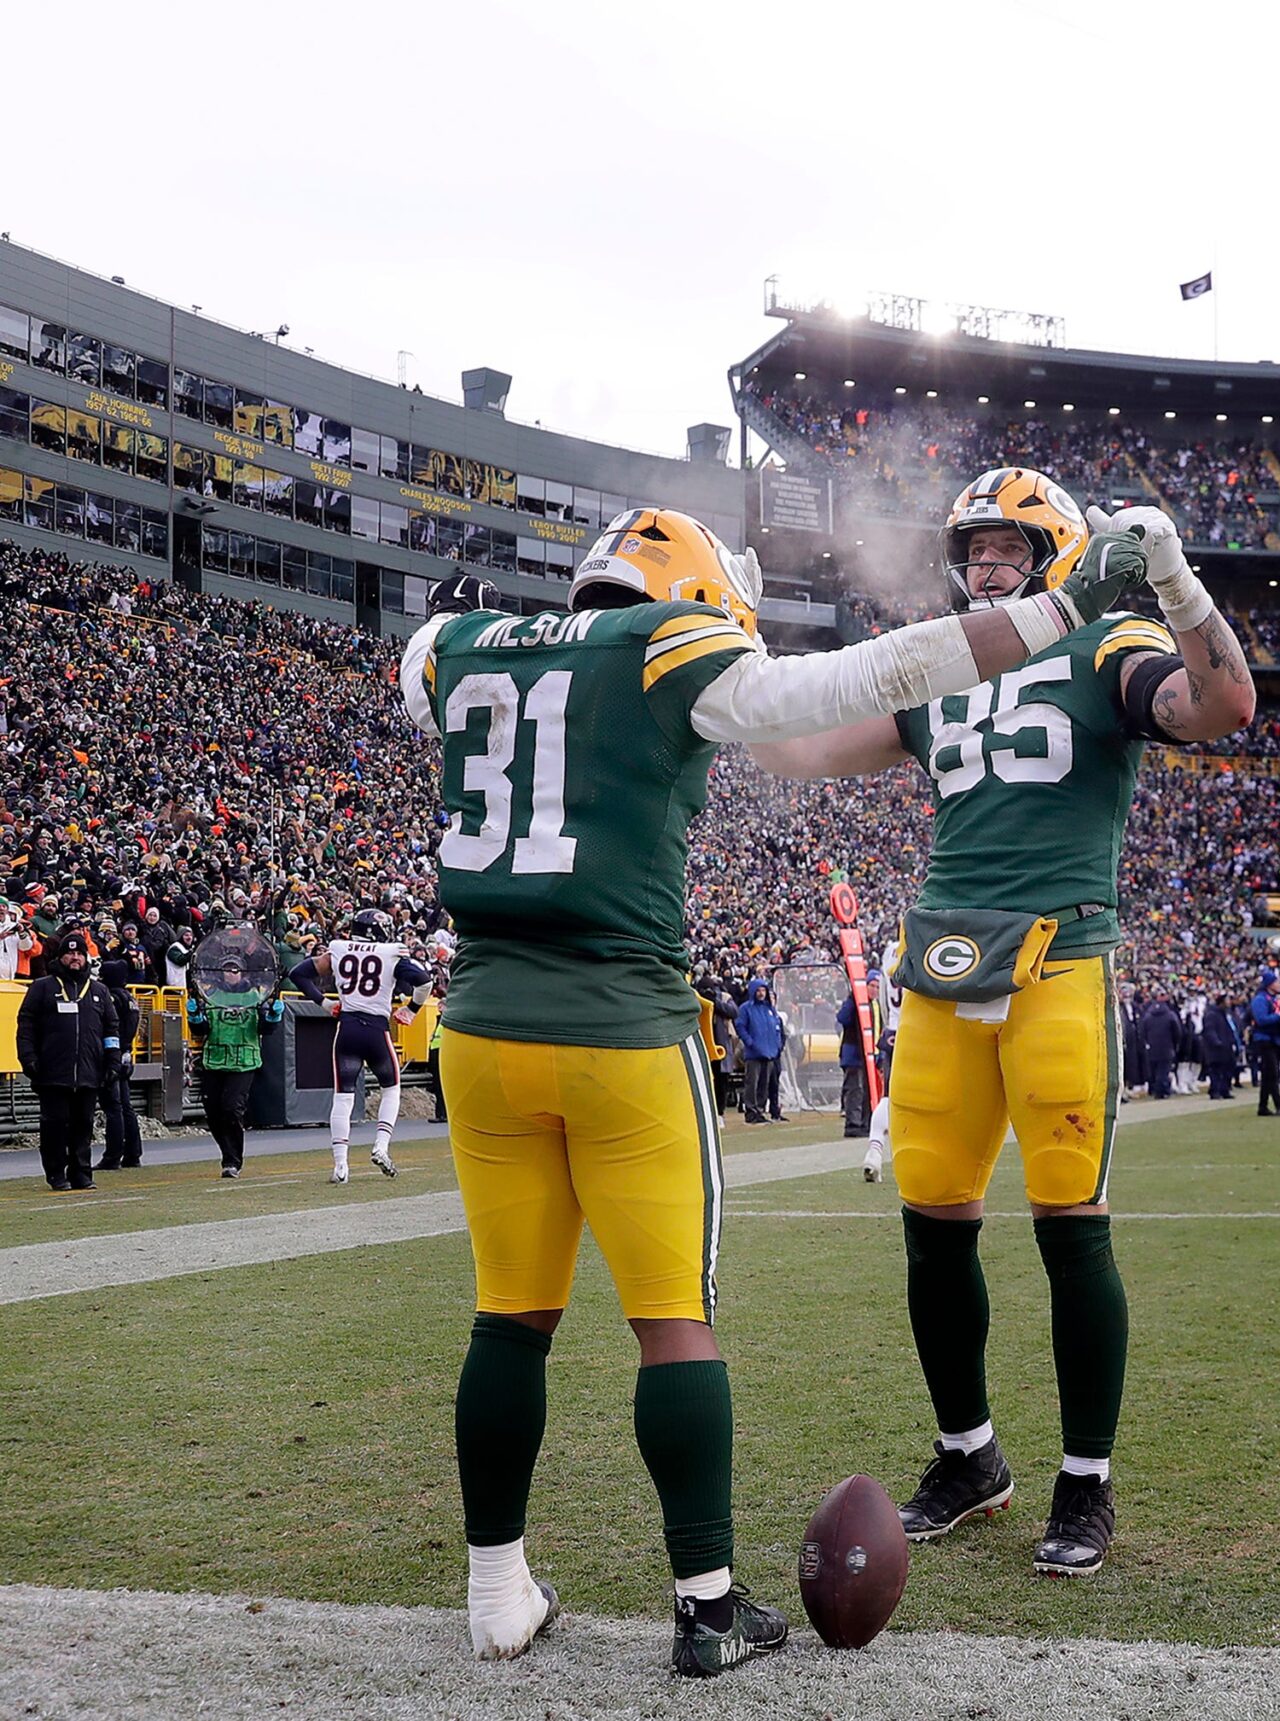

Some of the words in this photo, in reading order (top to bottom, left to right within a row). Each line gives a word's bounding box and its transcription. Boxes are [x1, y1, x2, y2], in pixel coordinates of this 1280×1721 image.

[90, 392, 109, 406] PAUL
[110, 400, 147, 417] HORNUNG
[214, 432, 240, 446] REGGIE
[242, 441, 264, 455] WHITE
[310, 462, 332, 475] BRETT
[333, 468, 352, 481] FAVRE
[400, 487, 432, 502] CHARLES
[434, 496, 472, 512] WOODSON
[528, 519, 555, 531] LEROY
[557, 526, 586, 537] BUTLER
[927, 654, 1073, 800] 85
[438, 670, 578, 874] 31
[347, 943, 377, 953] SWEAT
[928, 940, 974, 976] G
[339, 954, 383, 997] 98
